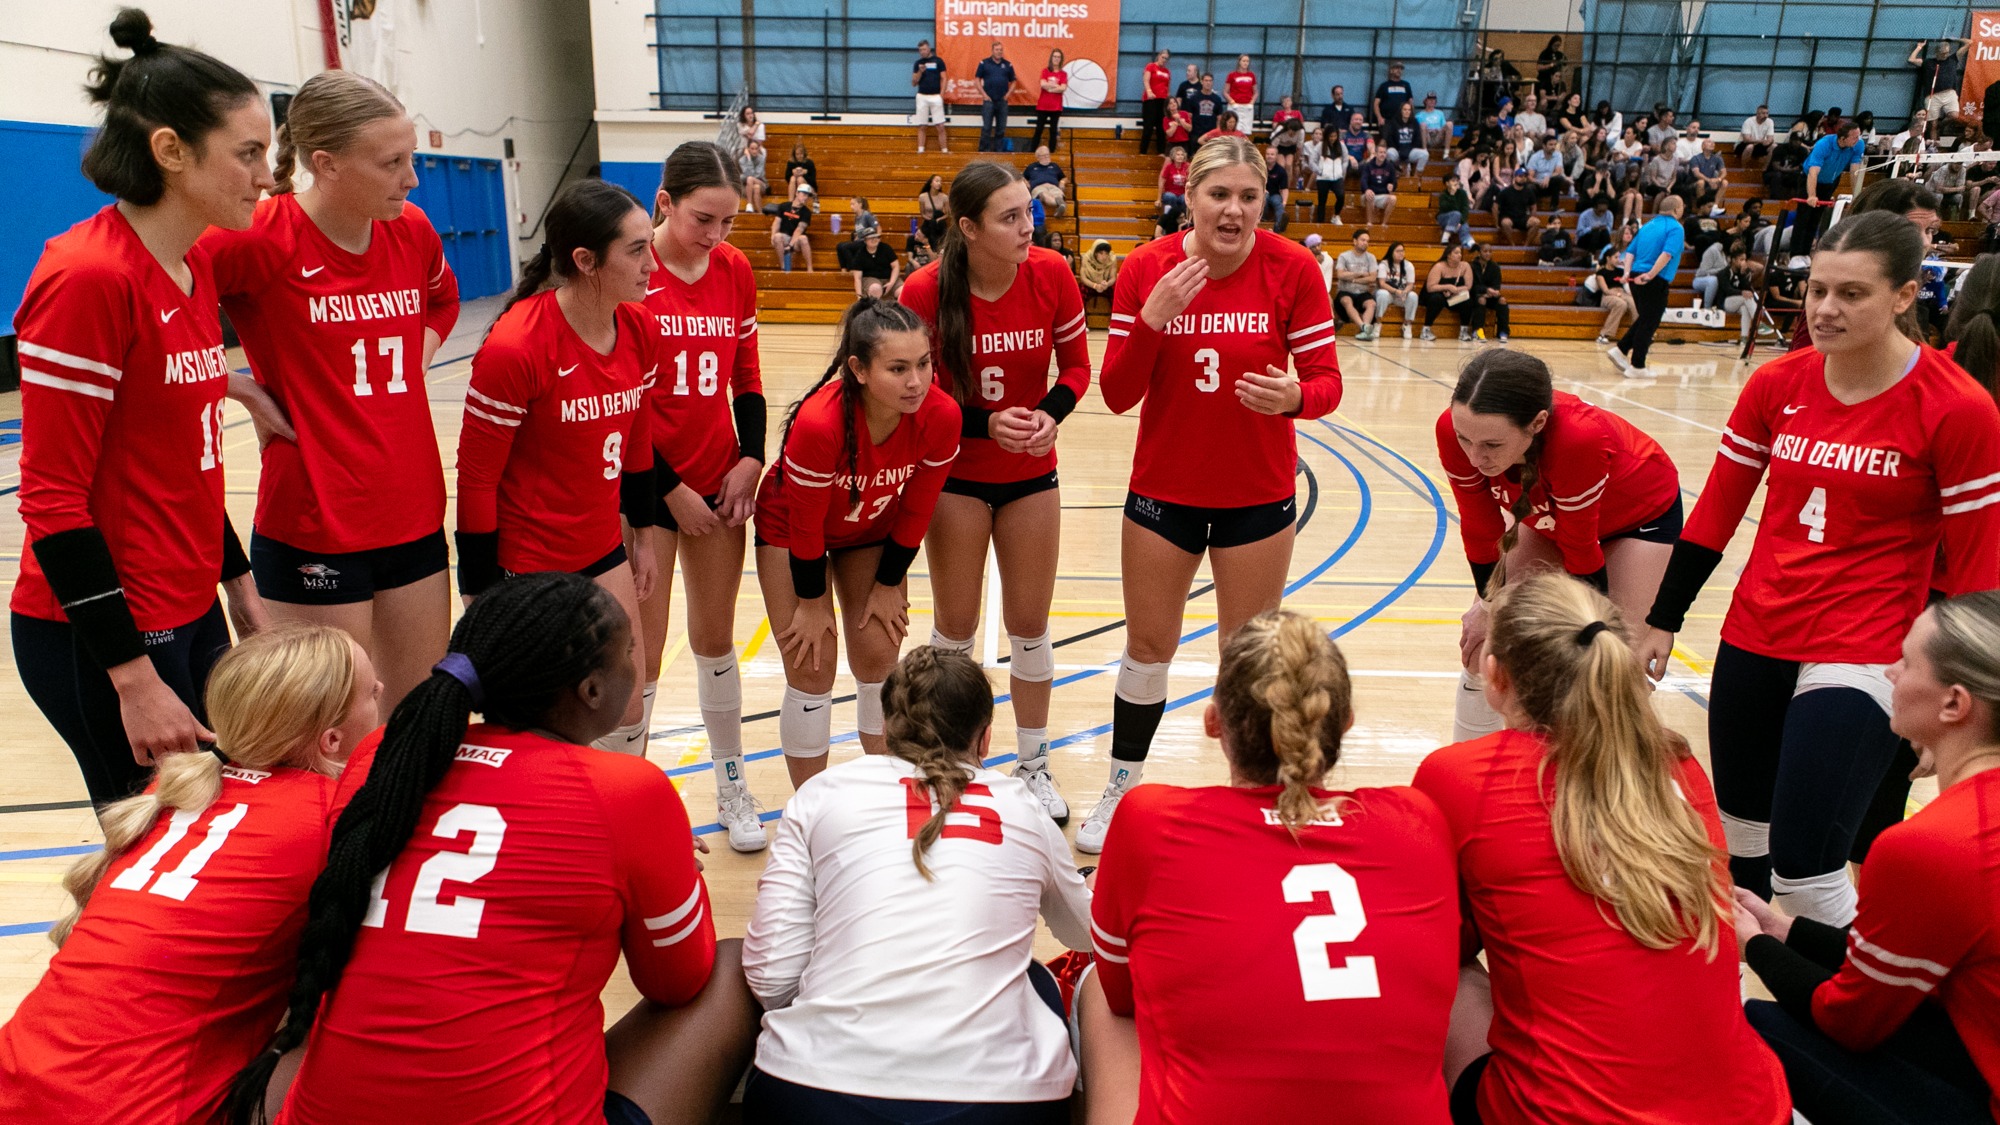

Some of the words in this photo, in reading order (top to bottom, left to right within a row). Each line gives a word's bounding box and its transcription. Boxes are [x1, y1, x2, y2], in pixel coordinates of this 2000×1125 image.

[944, 0, 1088, 18] Humankindness
[944, 17, 959, 36] is
[962, 20, 974, 36] a
[977, 17, 1020, 37] slam
[1023, 18, 1074, 39] dunk.
[309, 295, 356, 323] MSU
[355, 289, 421, 321] DENVER
[1200, 312, 1269, 334] DENVER
[656, 315, 683, 336] SU
[981, 328, 1045, 354] DENVER
[164, 351, 203, 384] MSU
[350, 336, 408, 396] 17
[673, 350, 719, 397] 18
[1194, 348, 1220, 393] 3
[981, 366, 1005, 402] 6
[561, 399, 600, 422] MSU
[602, 386, 643, 417] DENVE
[602, 431, 623, 480] 9
[1771, 433, 1809, 463] MSU
[1807, 440, 1902, 477] DENVER
[870, 464, 915, 488] ENVE
[844, 494, 893, 523] 13
[1135, 496, 1161, 515] MSU
[1798, 486, 1827, 543] 4
[144, 634, 175, 646] DENVER
[455, 747, 506, 763] MAC
[899, 776, 1004, 846] 15
[110, 803, 249, 902] 11
[1281, 862, 1382, 1002] 2
